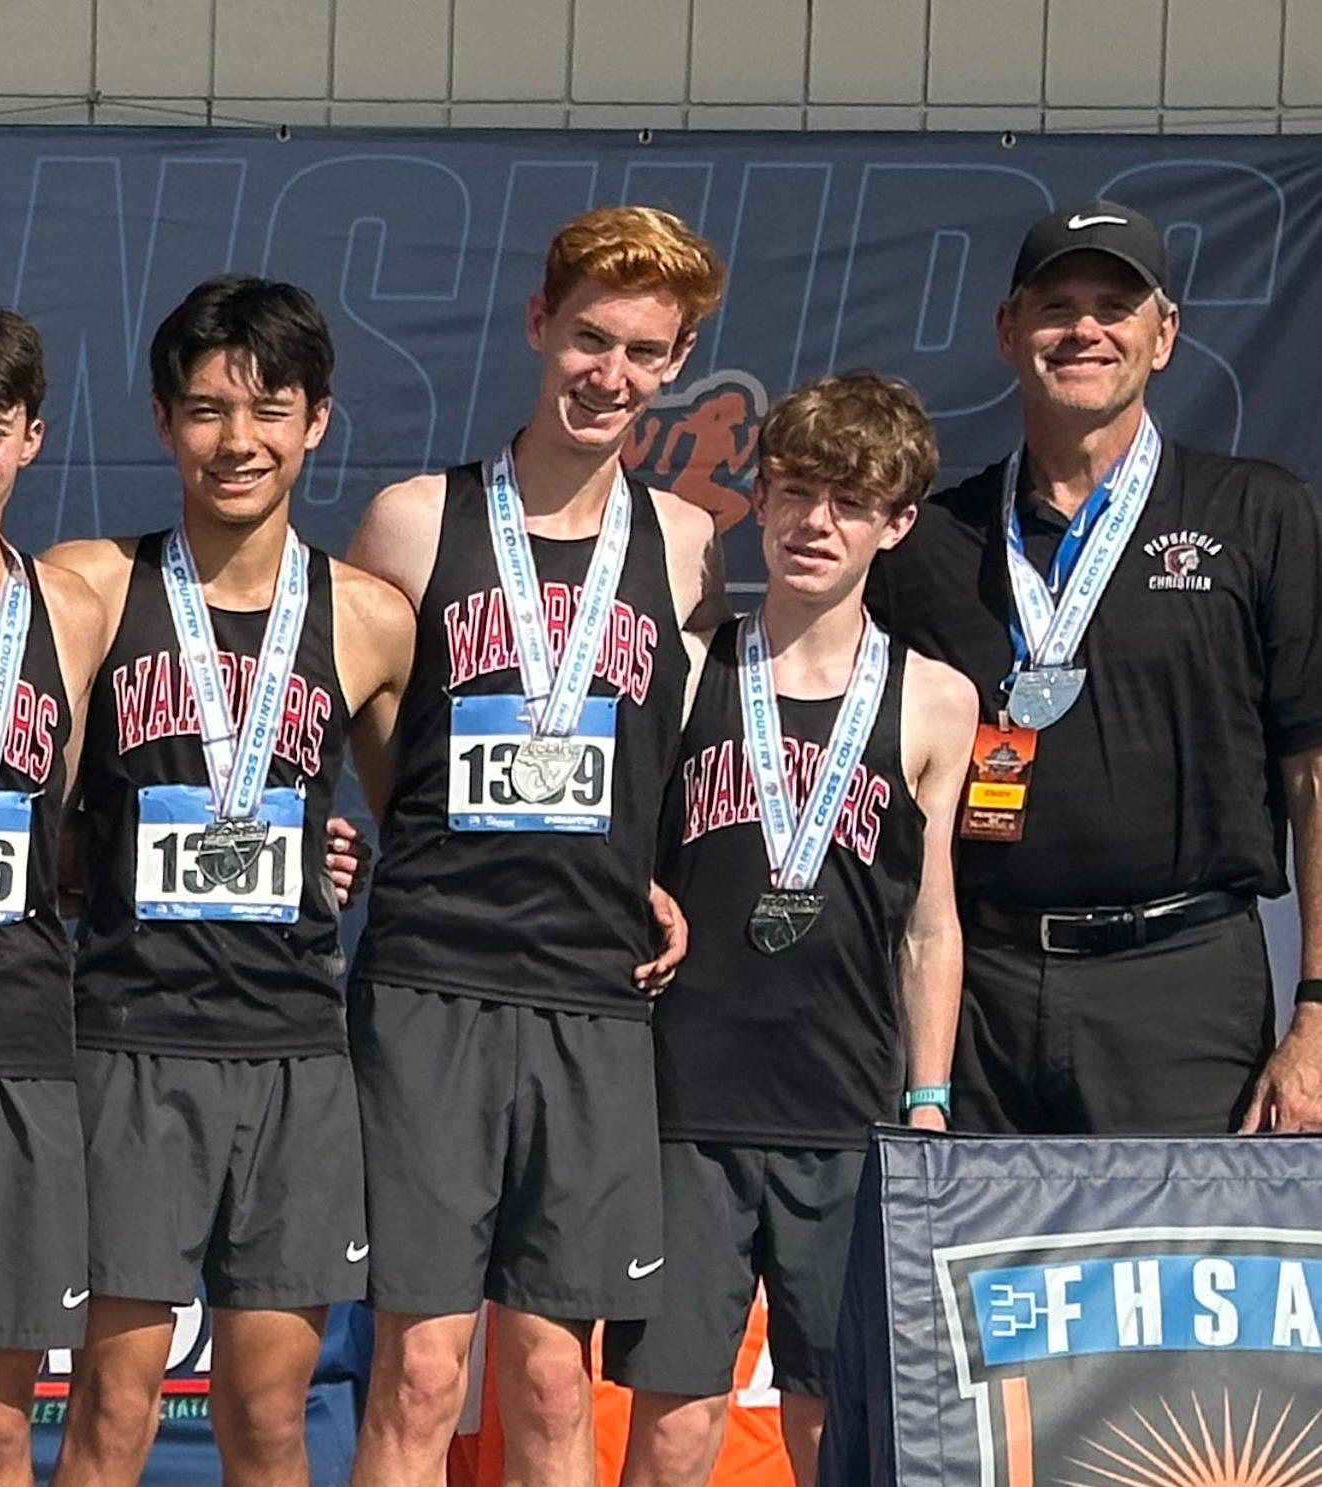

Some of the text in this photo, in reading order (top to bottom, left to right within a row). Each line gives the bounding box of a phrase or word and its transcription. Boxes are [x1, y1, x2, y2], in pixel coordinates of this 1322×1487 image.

[495, 474, 528, 601] CROSS COUNTRY
[1078, 474, 1142, 598] CROSS COUNTRY
[172, 567, 201, 640] COUNTRY
[238, 672, 279, 809] CROSS COUNTRY
[746, 644, 774, 771] CROSS COUNTRY
[814, 697, 867, 829] CROSS COUNTRY
[459, 743, 605, 807] 139
[152, 832, 287, 896] 131
